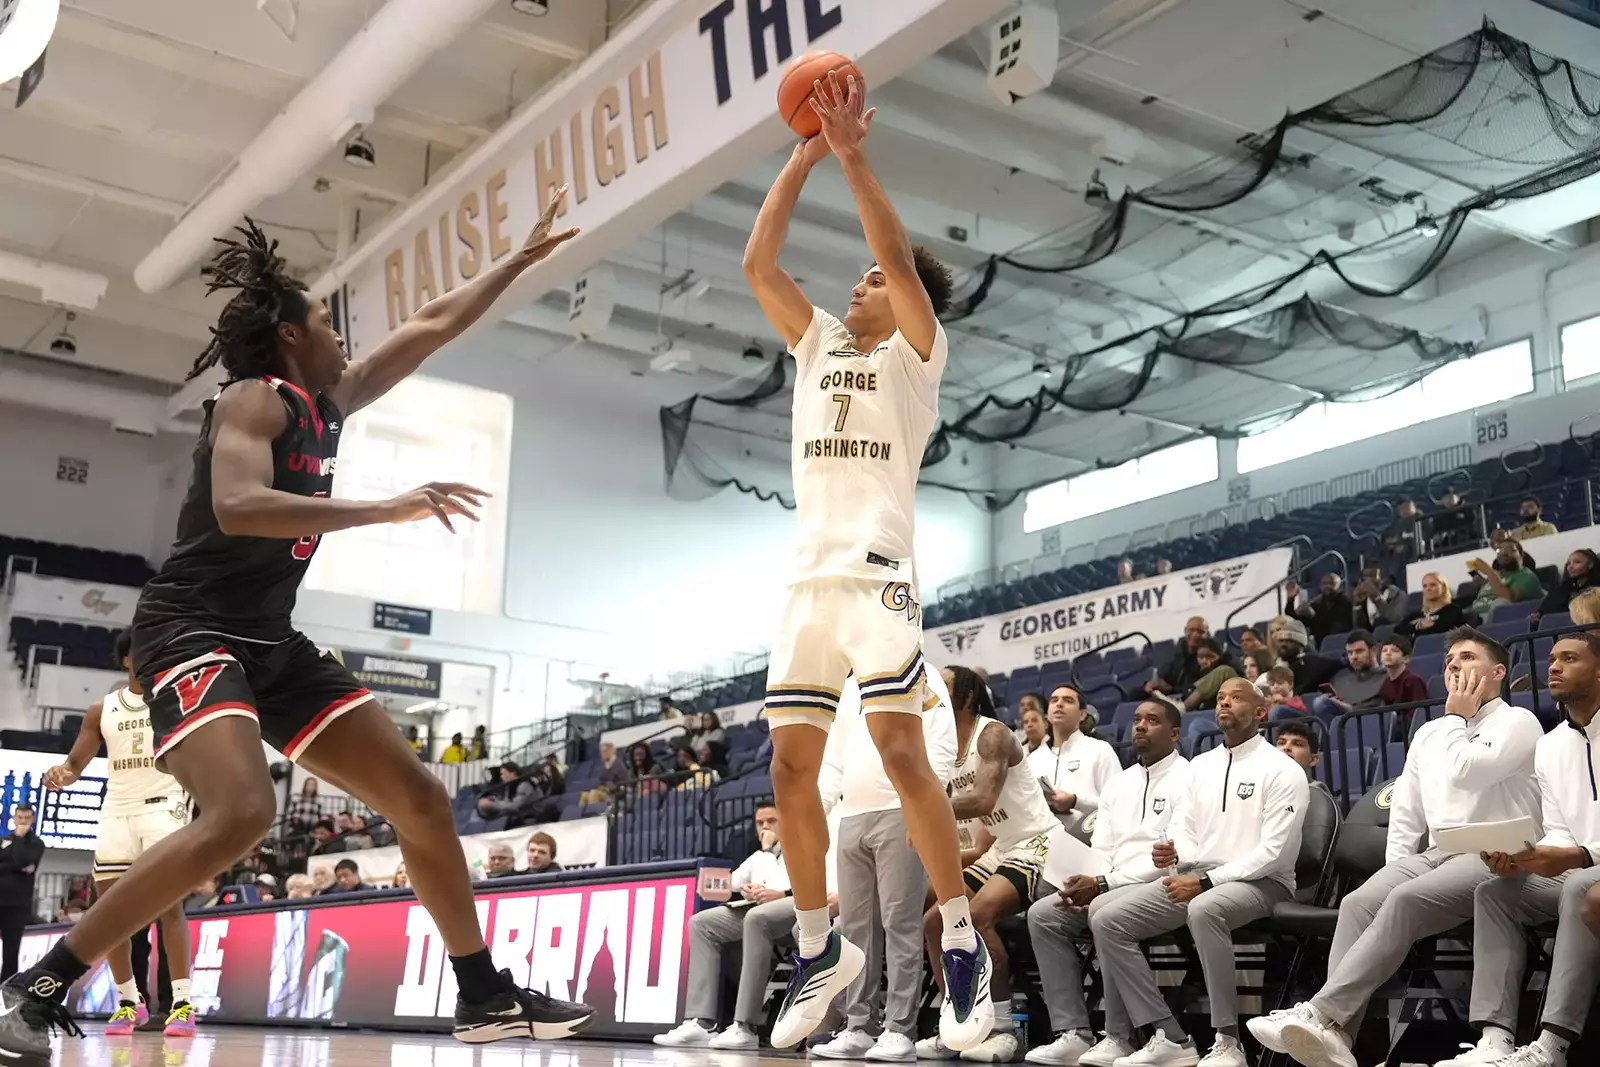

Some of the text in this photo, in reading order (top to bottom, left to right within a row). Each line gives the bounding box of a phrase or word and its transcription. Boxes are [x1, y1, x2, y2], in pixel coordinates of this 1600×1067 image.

[384, 168, 512, 332] RAISE
[534, 50, 668, 219] HIGH
[820, 370, 877, 392] GORGE
[833, 394, 851, 432] 7
[1477, 421, 1508, 446] 203
[57, 465, 88, 485] 222
[287, 452, 337, 476] UVAWIS
[1000, 584, 1168, 641] GEORGE'S ARMY
[1034, 637, 1092, 660] SECTION
[118, 717, 151, 732] GEORG
[131, 732, 144, 754] 2
[113, 756, 155, 771] WASHINGT
